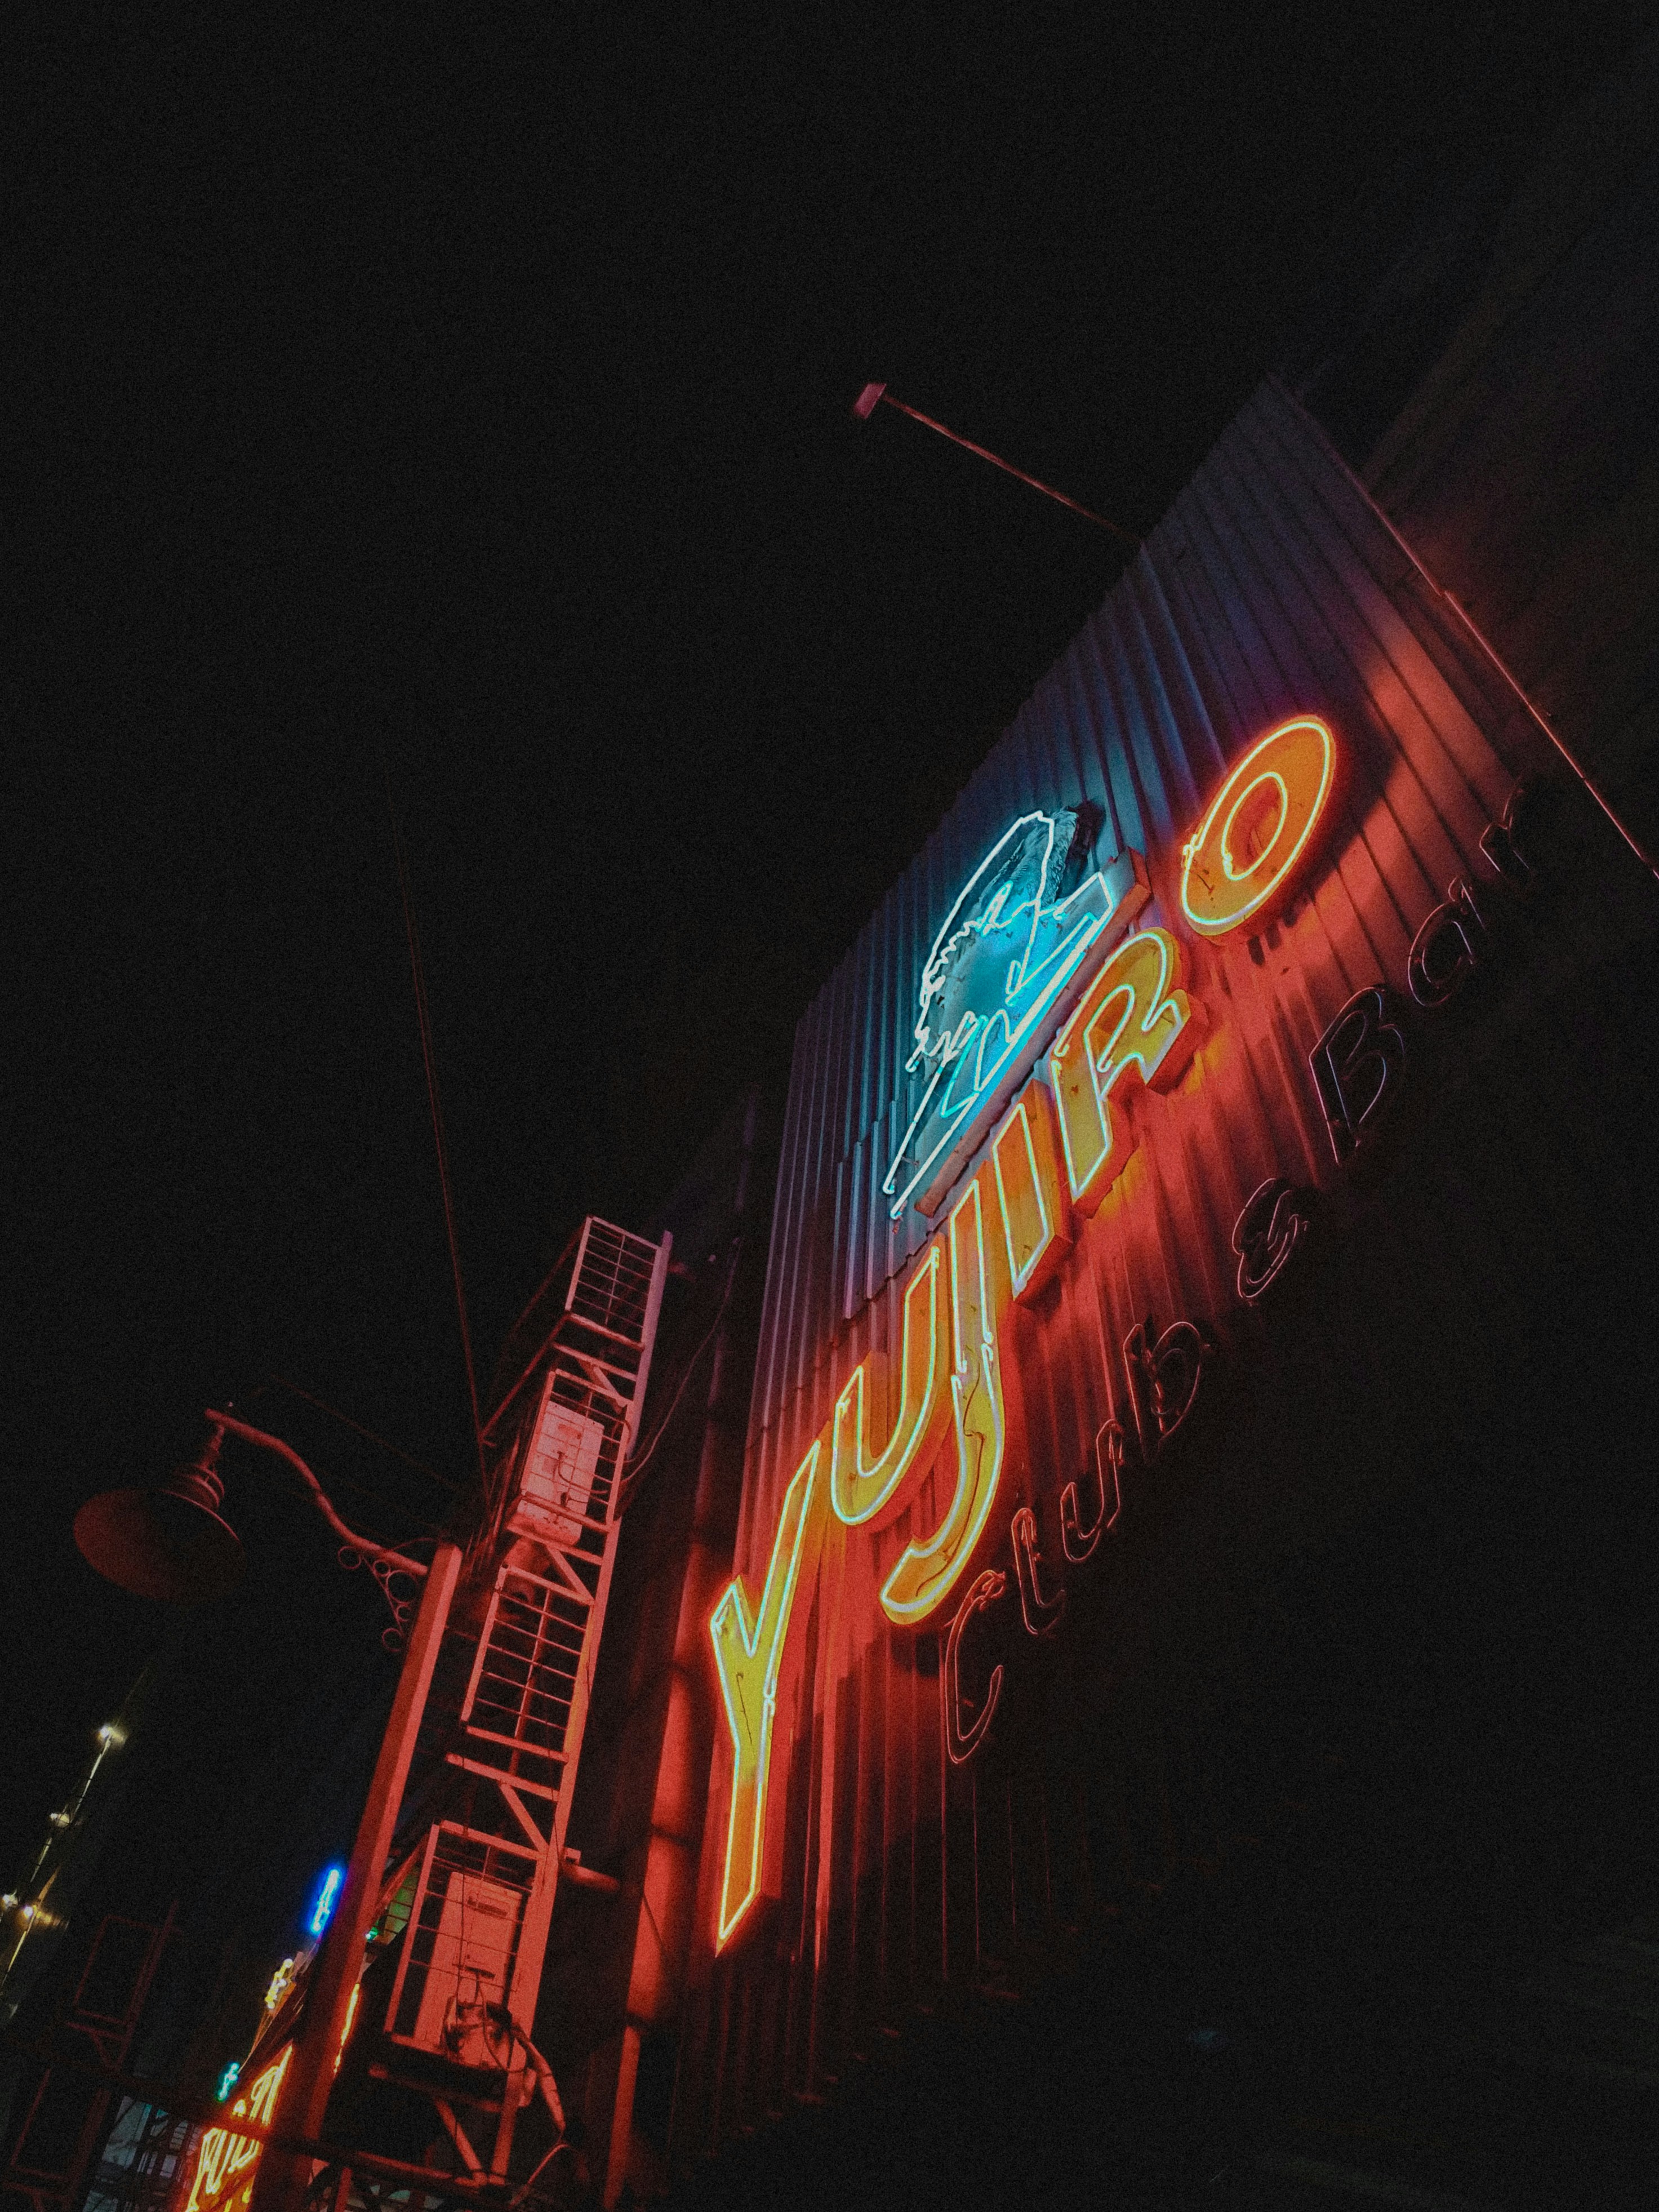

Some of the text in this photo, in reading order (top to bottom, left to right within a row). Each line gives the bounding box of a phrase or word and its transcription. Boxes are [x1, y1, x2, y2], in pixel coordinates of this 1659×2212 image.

[709, 711, 1337, 1956] YUJIRO
[944, 1321, 1208, 1764] Club
[1308, 787, 1531, 1166] Bar
